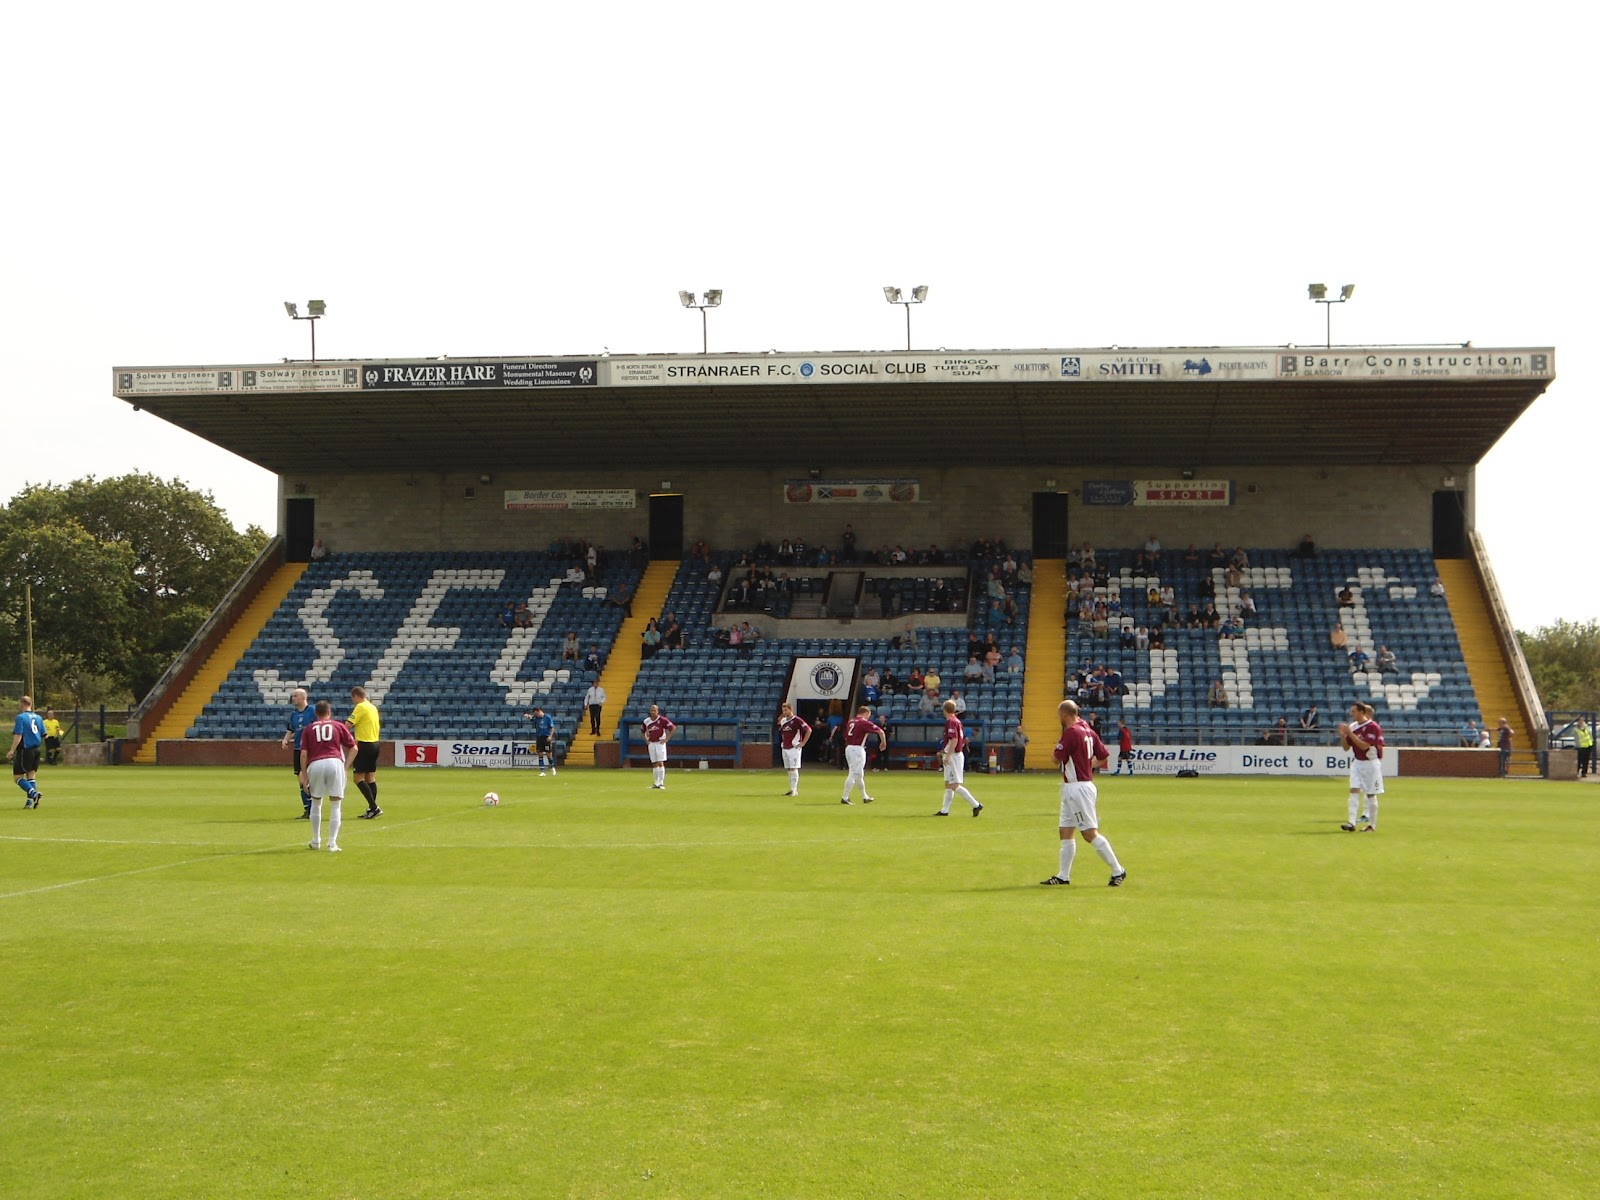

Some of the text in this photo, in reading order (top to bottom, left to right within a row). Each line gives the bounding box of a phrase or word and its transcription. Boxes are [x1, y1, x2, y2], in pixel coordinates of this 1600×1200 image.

[1218, 361, 1268, 370] ESTATE AGENTS
[1304, 354, 1522, 367] Barr Construction
[667, 364, 796, 378] STRANRAER F.C.
[820, 362, 926, 375] SOCIAL CLUB
[1013, 362, 1050, 372] SOLICITORS
[1099, 363, 1162, 375] SMITH
[1411, 368, 1450, 376] DUMFRIES
[1476, 367, 1522, 375] EDINBURGH
[136, 371, 216, 380] Solway Engineers
[259, 368, 341, 378] Solway Precast
[383, 365, 496, 383] FRAZER HARE
[503, 370, 577, 378] Monumental Masonary
[503, 379, 533, 387] Wedding
[1147, 481, 1227, 489] Supporting
[523, 491, 567, 499] Border Cars
[1159, 491, 1213, 500] SPORT
[31, 719, 39, 735] 6
[312, 723, 333, 742] 10
[847, 722, 855, 736] 2
[451, 743, 499, 755] Stena
[502, 743, 532, 755] Lin
[1084, 735, 1094, 760] 11
[416, 746, 426, 762] S
[1179, 749, 1217, 761] Line
[453, 757, 534, 767] Making good time
[1165, 763, 1189, 772] good
[1243, 755, 1355, 769] Direct to Bel
[1374, 780, 1379, 788] 6
[1074, 811, 1084, 823] 11
